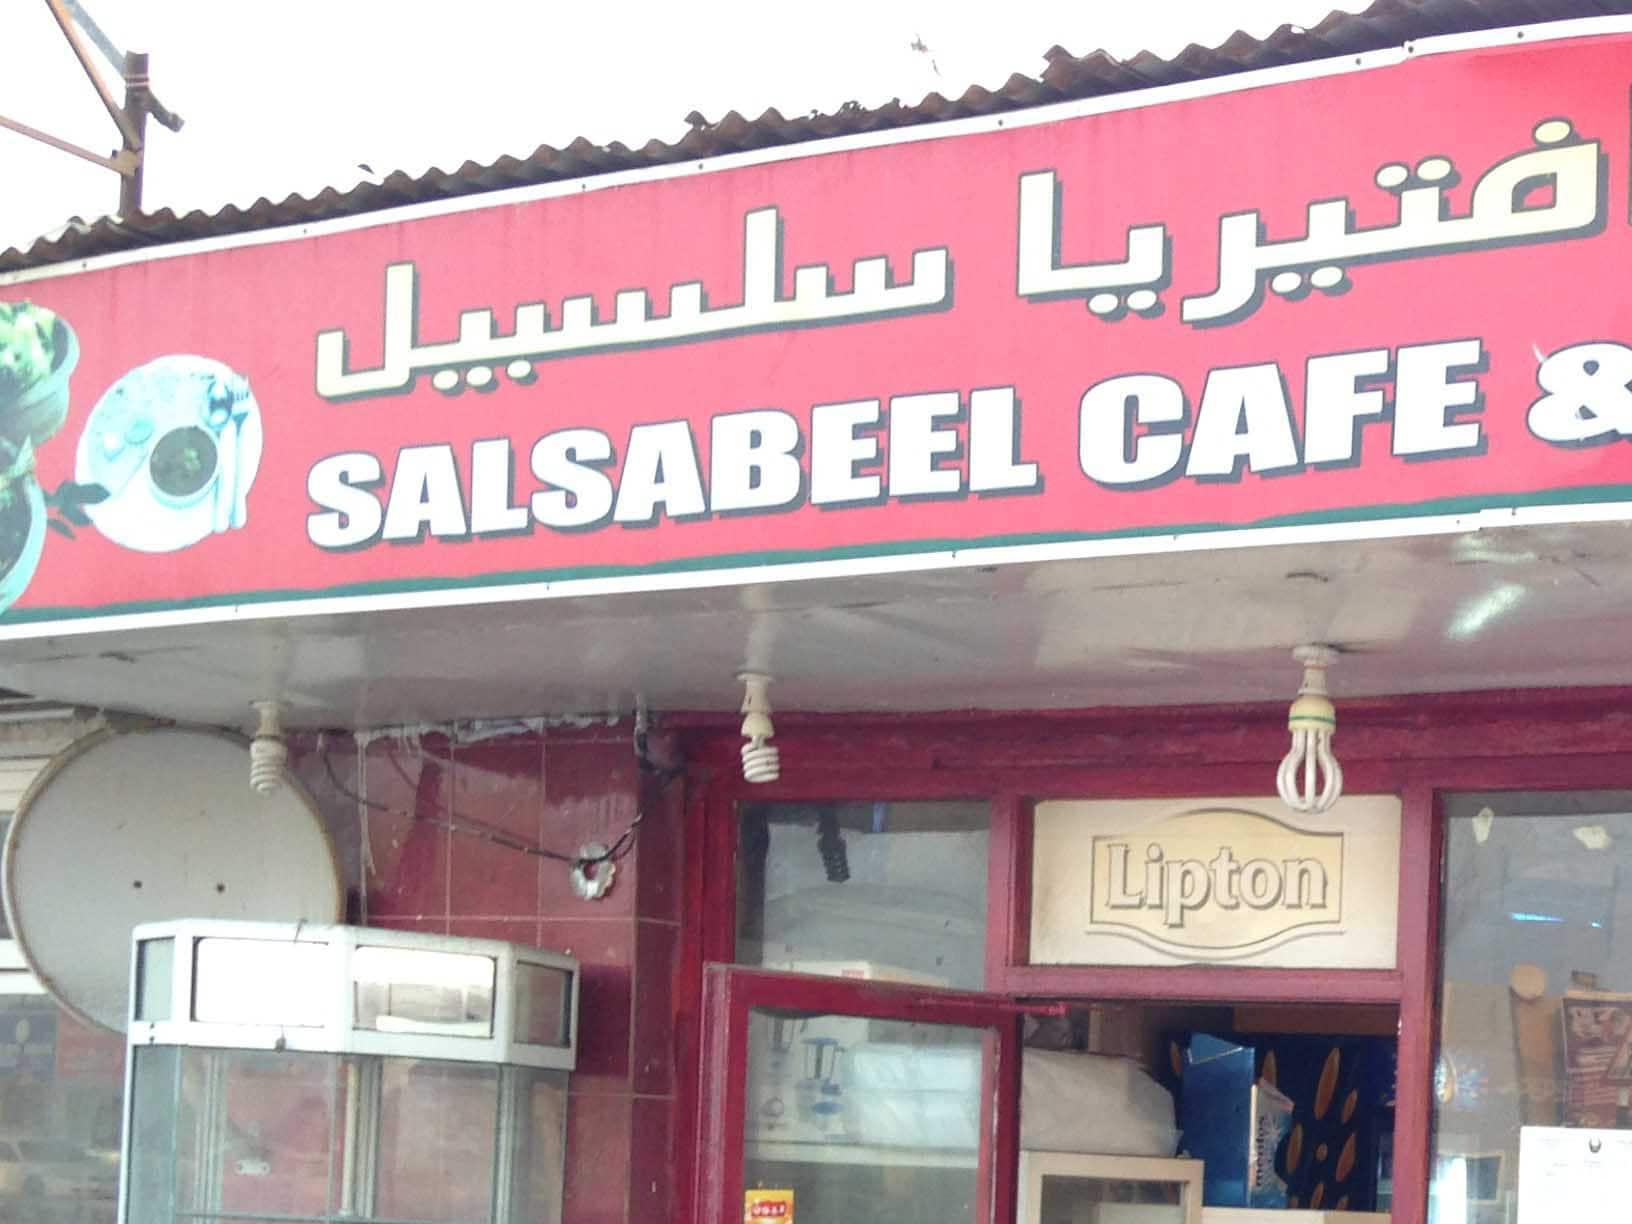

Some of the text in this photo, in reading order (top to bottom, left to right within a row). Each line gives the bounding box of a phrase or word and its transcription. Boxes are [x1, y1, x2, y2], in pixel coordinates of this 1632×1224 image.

[315, 206, 950, 399] سلسبيل
[306, 386, 1040, 549] SALSABEEL
[1079, 339, 1484, 486] CAFE
[1104, 842, 1328, 928] Lipton
